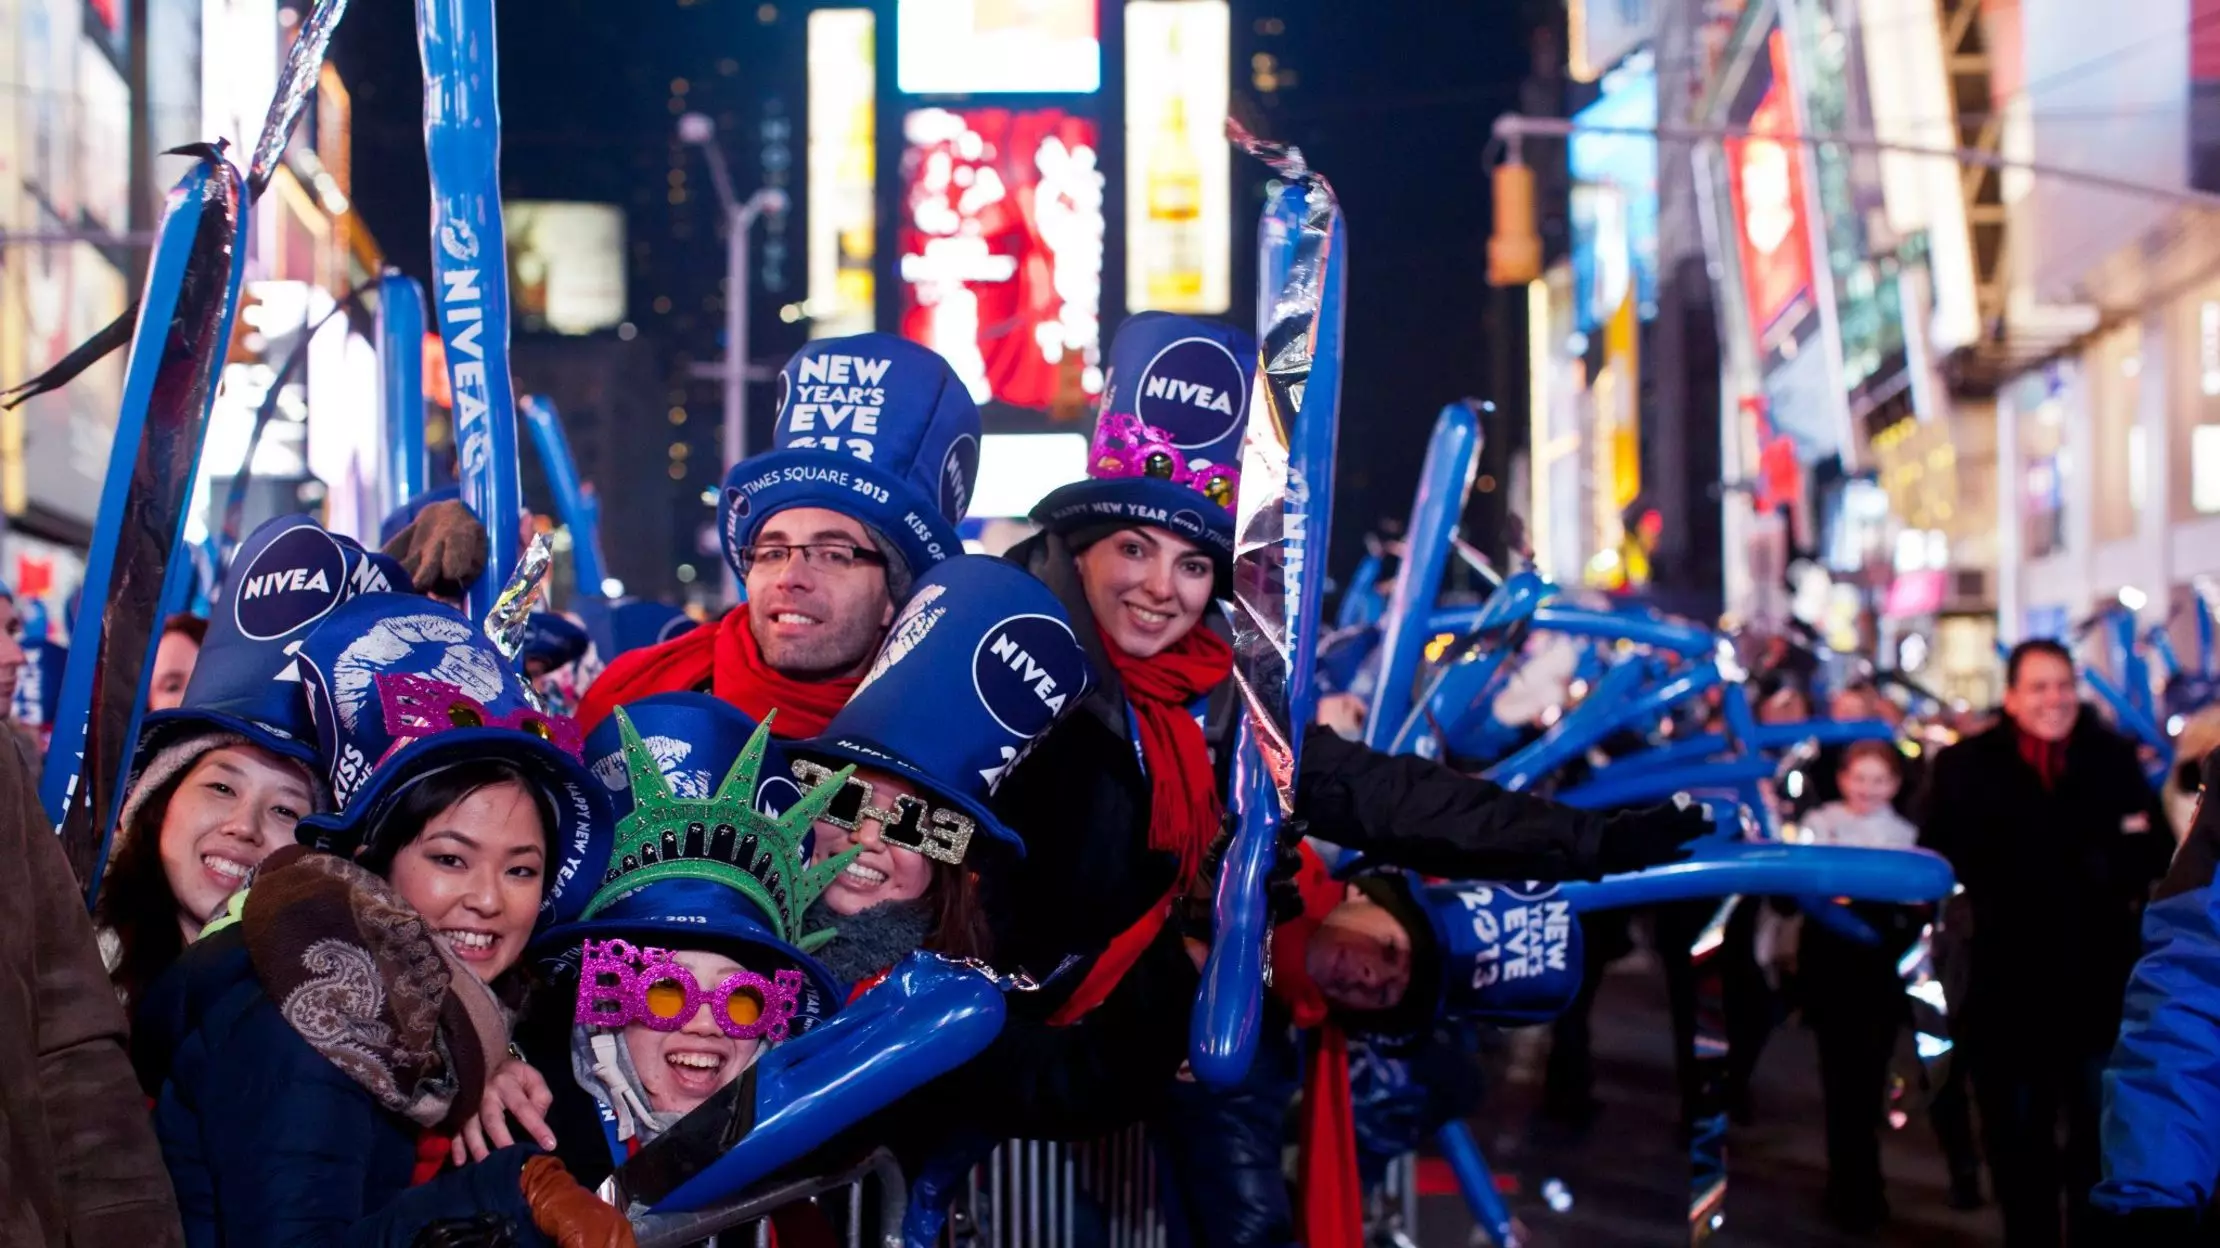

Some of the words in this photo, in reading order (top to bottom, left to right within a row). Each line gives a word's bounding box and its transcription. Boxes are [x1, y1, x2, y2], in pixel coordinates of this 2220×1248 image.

[444, 268, 488, 430] NIVEA
[798, 354, 892, 387] NEW
[797, 385, 885, 405] YEAR'S
[1145, 375, 1233, 416] NIVEA
[789, 404, 881, 435] EVE
[742, 470, 781, 498] TIMES
[784, 467, 849, 487] SQUARE
[852, 477, 890, 504] 2013
[1091, 501, 1122, 515] NEW
[1127, 503, 1169, 523] YEAR
[1173, 516, 1199, 533] NIVEA
[904, 511, 929, 543] KISS
[927, 541, 945, 562] OF
[244, 568, 330, 600] NIVEA
[990, 632, 1067, 717] NIVEA
[333, 743, 364, 810] KISS
[563, 782, 591, 820] HAPPY
[573, 820, 591, 854] NEW
[552, 856, 582, 899] YEAR
[665, 915, 708, 924] 2013
[1456, 886, 1500, 989] 2013
[1544, 900, 1569, 971] NEW
[1503, 906, 1528, 981] EVE
